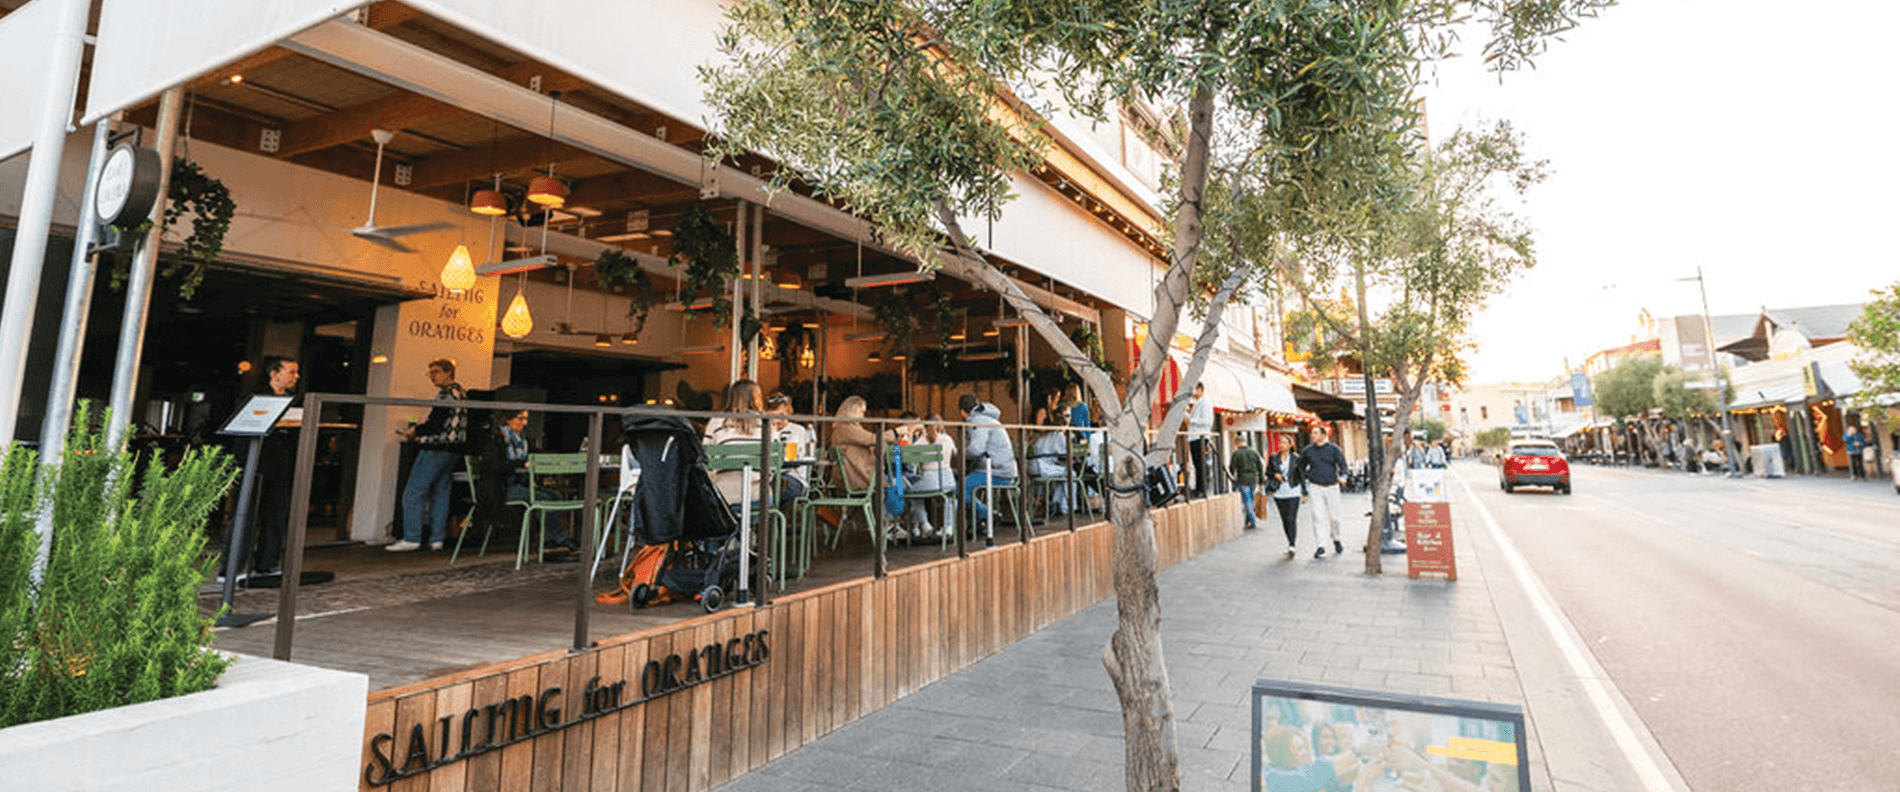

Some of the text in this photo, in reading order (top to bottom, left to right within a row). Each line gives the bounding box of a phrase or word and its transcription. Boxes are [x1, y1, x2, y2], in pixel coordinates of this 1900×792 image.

[439, 303, 459, 319] for
[409, 320, 484, 344] ORANGES
[365, 629, 771, 787] SAILING for ORANGES
